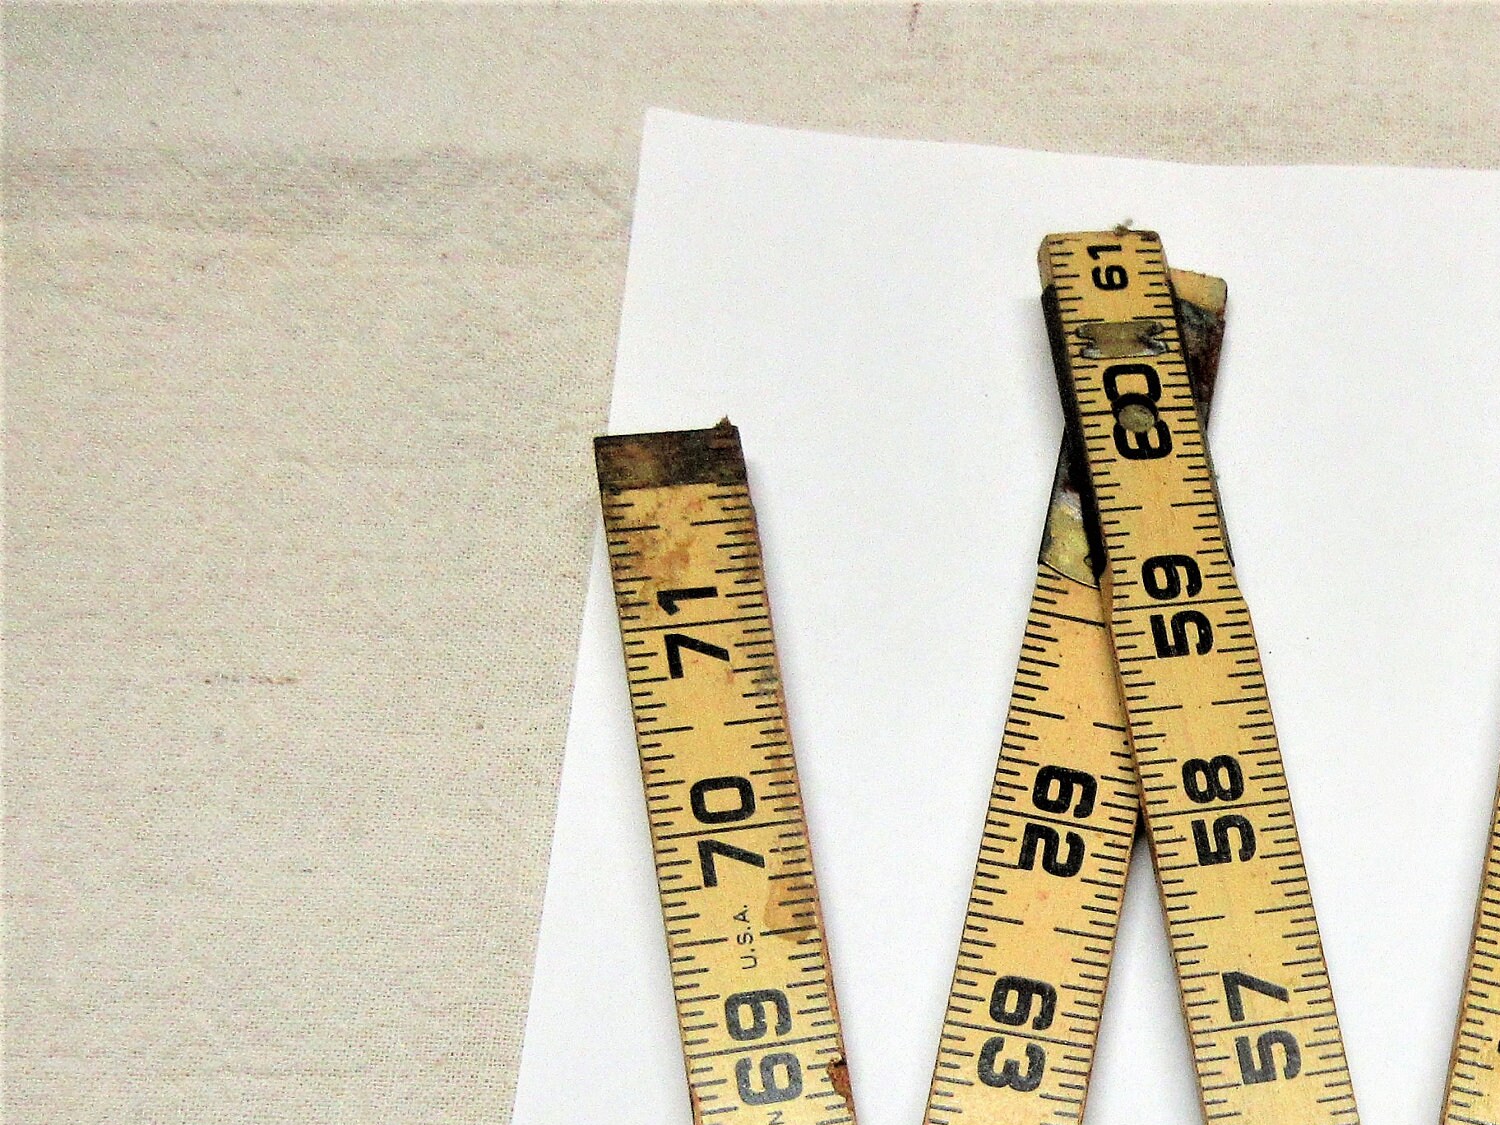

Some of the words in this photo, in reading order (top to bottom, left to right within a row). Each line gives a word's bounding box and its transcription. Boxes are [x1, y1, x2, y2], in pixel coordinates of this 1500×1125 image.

[1087, 244, 1128, 292] 61
[1102, 363, 1172, 460] 60
[656, 586, 730, 679] 71
[1141, 553, 1214, 658] 59
[690, 775, 765, 888] 70
[1018, 765, 1097, 879] 62
[1181, 754, 1257, 867] 58
[733, 903, 758, 970] U.S.A.
[725, 989, 803, 1106] 69
[976, 975, 1057, 1092] 63
[1221, 970, 1302, 1085] 57
